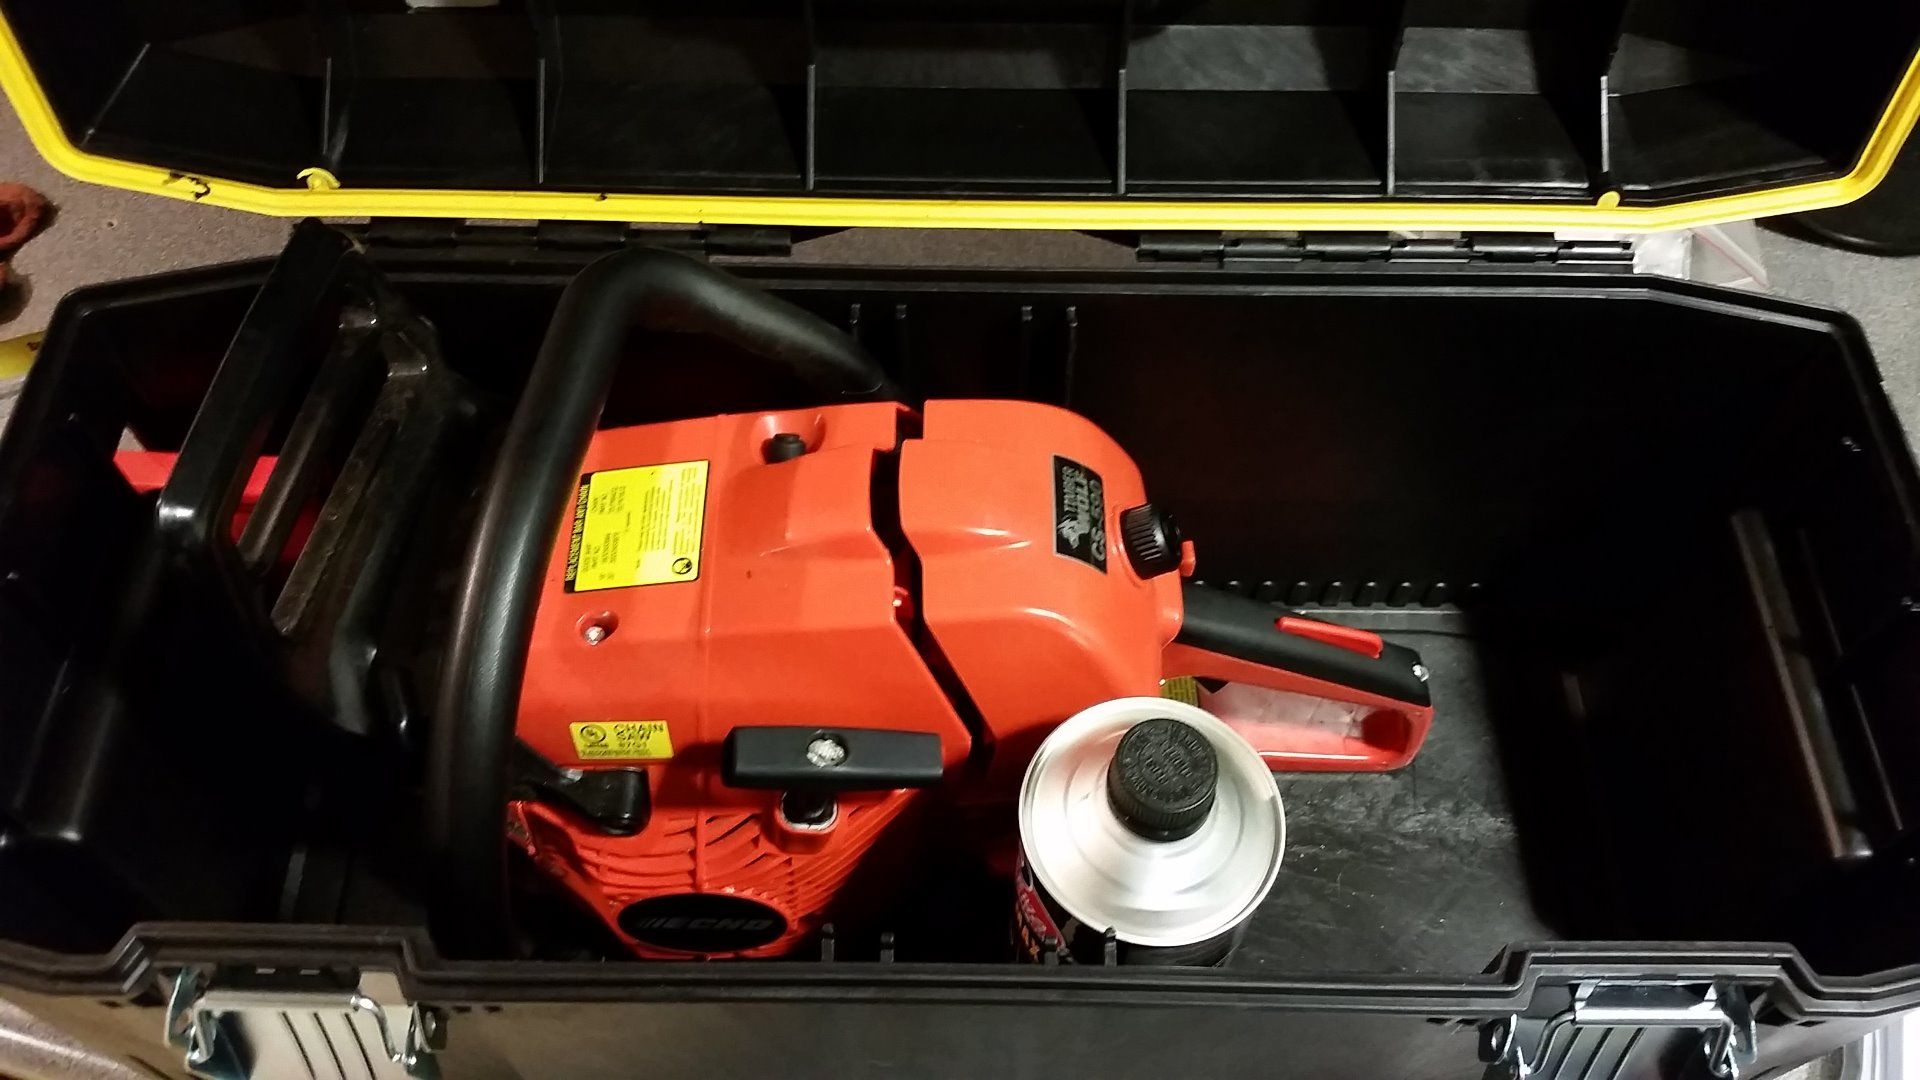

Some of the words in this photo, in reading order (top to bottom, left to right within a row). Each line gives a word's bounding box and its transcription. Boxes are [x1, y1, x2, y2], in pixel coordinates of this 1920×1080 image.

[614, 723, 664, 733] CHAIN
[615, 730, 651, 741] SAW
[663, 917, 774, 931] ECHO
